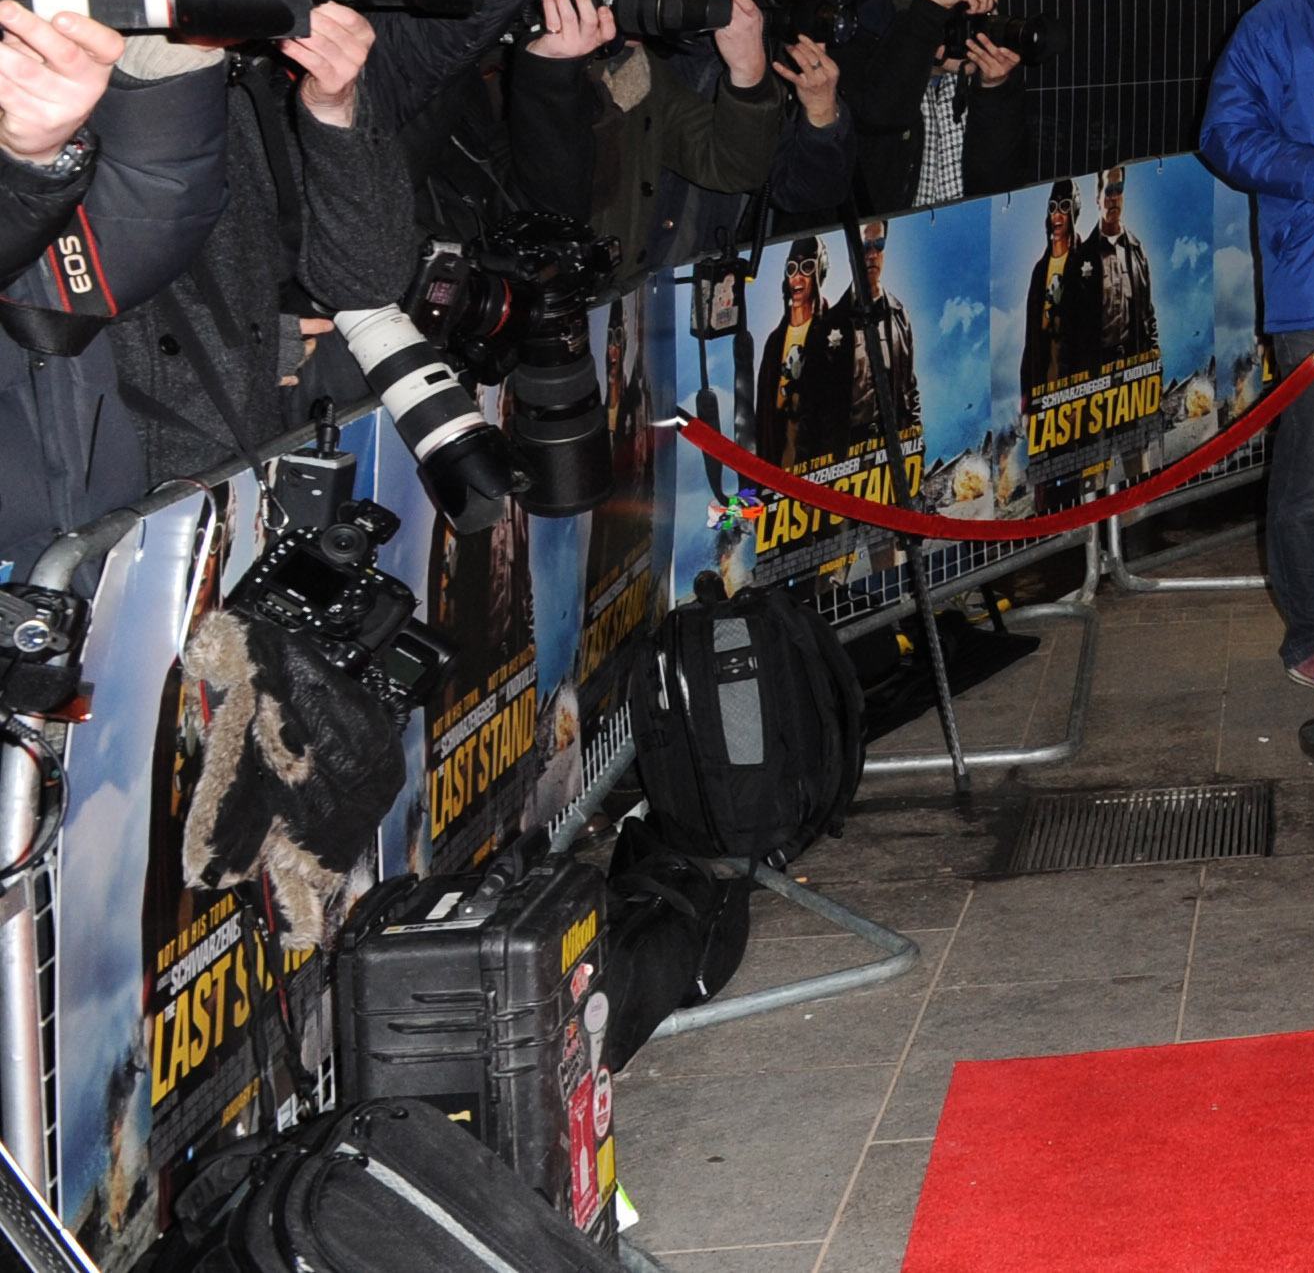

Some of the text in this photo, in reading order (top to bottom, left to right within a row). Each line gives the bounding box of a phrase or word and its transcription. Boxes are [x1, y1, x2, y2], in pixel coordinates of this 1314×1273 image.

[58, 234, 93, 295] EOS
[1041, 358, 1162, 410] SCHWARZENEGGER KNOXVILLE
[1028, 374, 1161, 456] LAST STAND
[875, 436, 924, 465] KNVILLE
[431, 686, 536, 841] LAST STAND
[157, 938, 176, 974] NOT
[191, 915, 208, 949] HIS
[151, 952, 233, 1107] LAST
